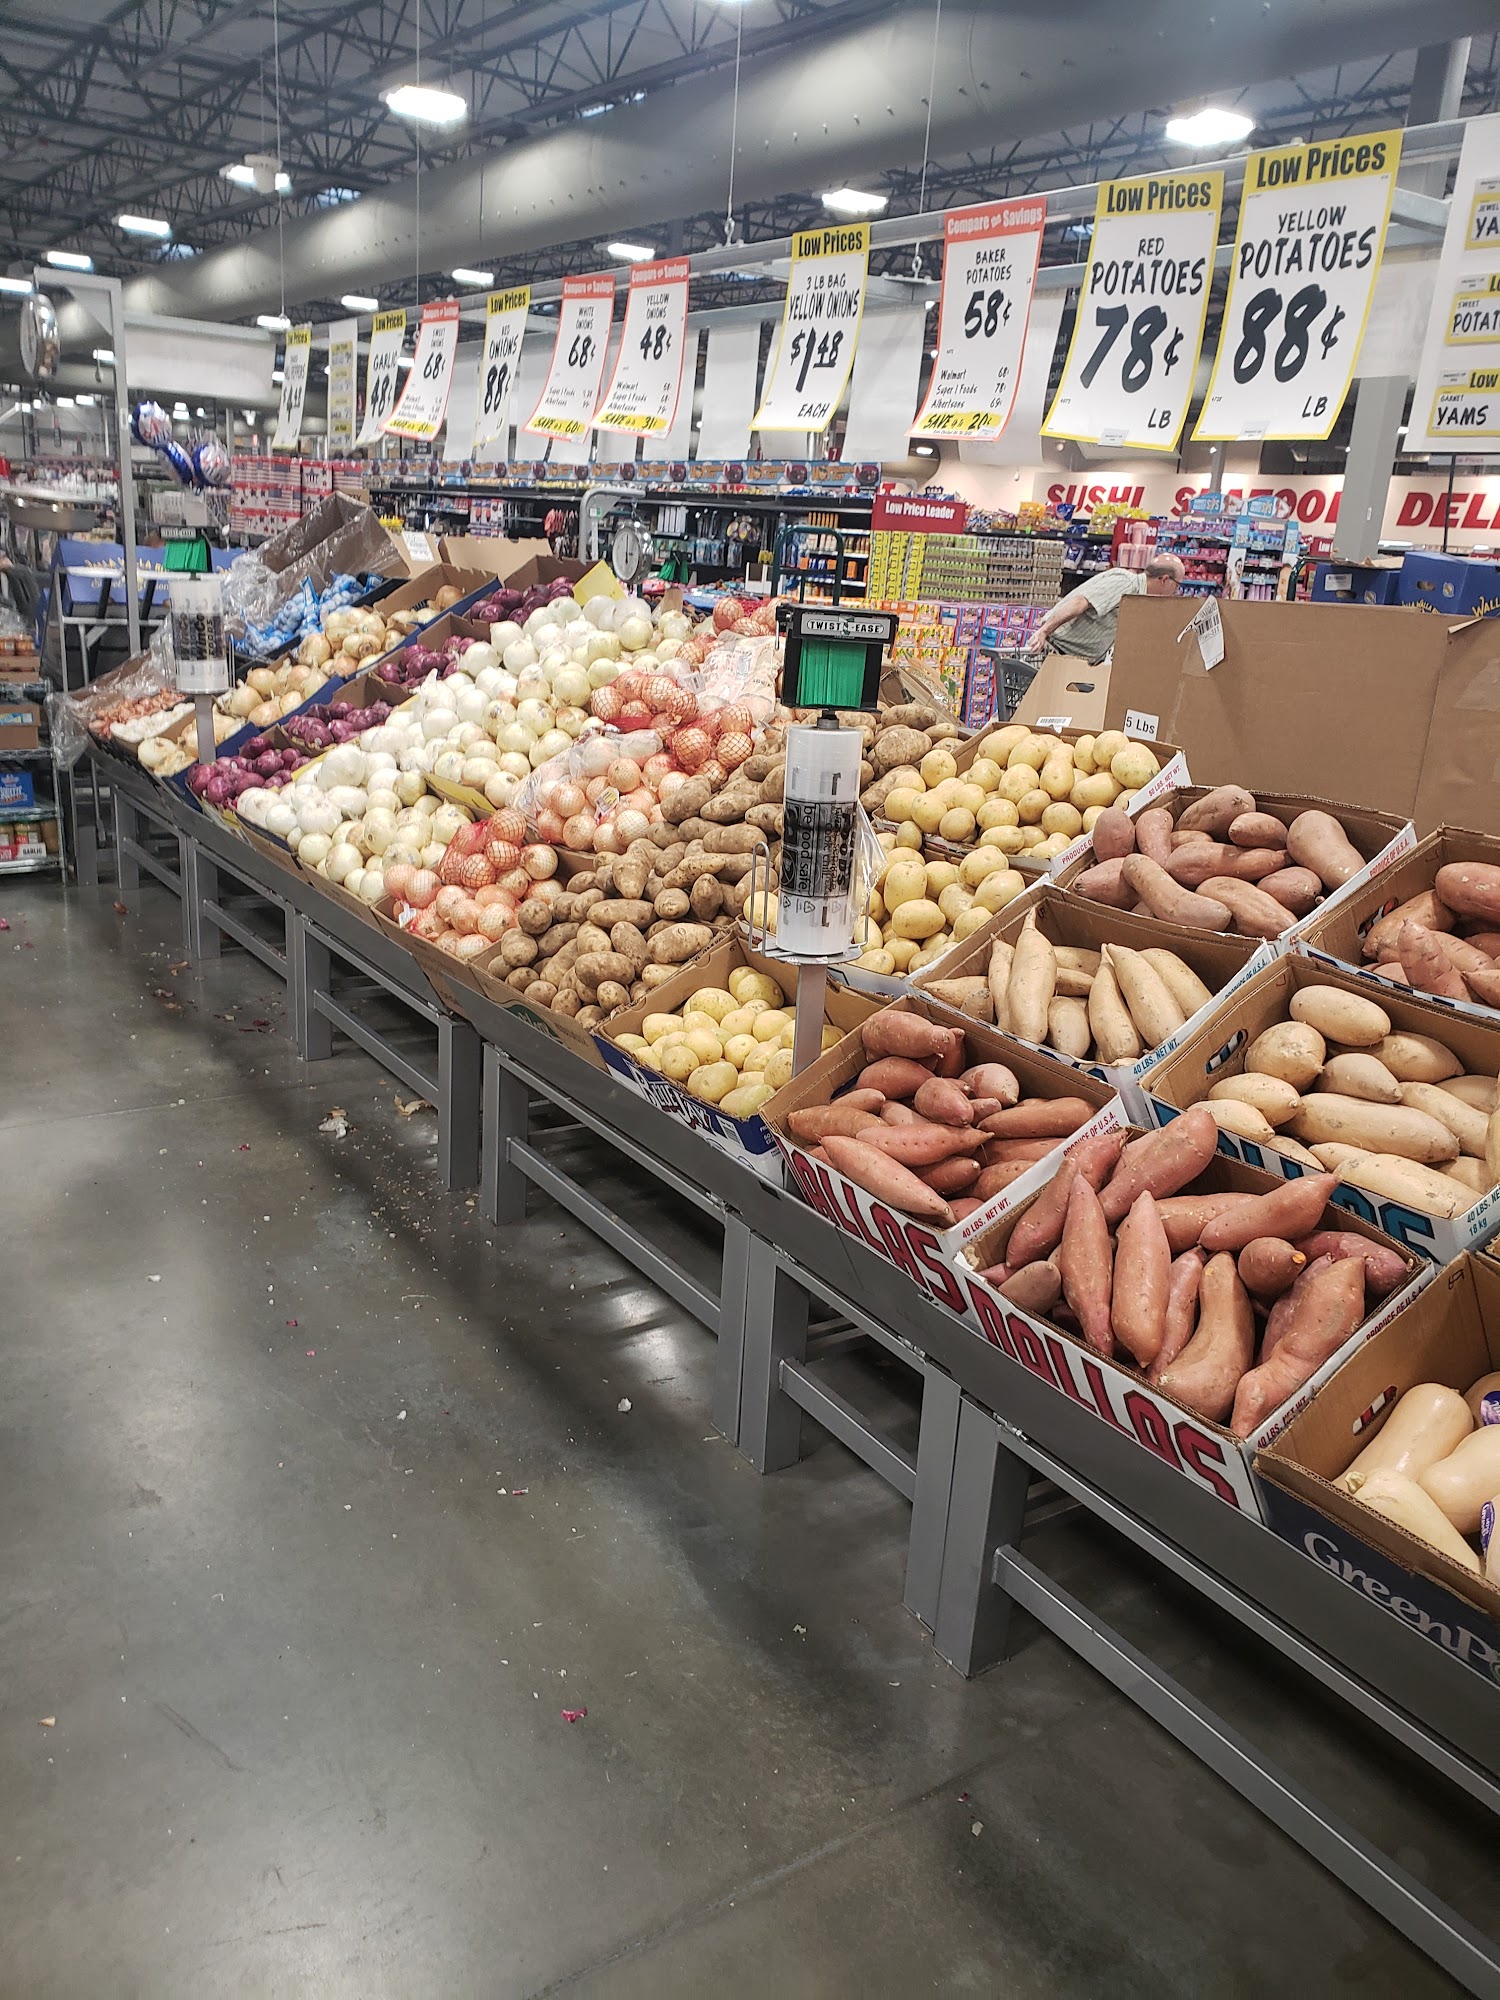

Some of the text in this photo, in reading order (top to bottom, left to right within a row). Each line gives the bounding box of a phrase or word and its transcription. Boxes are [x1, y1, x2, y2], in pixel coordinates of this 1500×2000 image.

[1257, 142, 1387, 188] Low Prices
[1107, 180, 1211, 213] Low Prices
[1478, 203, 1499, 212] JEWEL
[948, 215, 990, 235] Compare
[1003, 207, 1043, 227] Savings
[1278, 205, 1347, 234] YELLOW
[1476, 216, 1500, 239] YA
[799, 230, 862, 257] Low Prices
[1138, 237, 1165, 257] RED
[1239, 226, 1376, 280] POTATOES
[975, 248, 1006, 265] BAKER
[806, 273, 846, 291] 3 LB BAG
[966, 264, 1012, 285] POTATOES
[1090, 257, 1206, 296] POTATOES
[490, 291, 526, 314] Low Prices
[646, 293, 670, 306] YELLOW
[789, 288, 860, 321] YELLOW ONIONS
[1458, 300, 1480, 309] SWEET
[375, 314, 403, 331] Low Prices
[646, 306, 667, 320] ONIONS
[488, 334, 519, 361] ONIONS
[373, 351, 398, 371] GARLIC
[940, 369, 967, 380] Walmart
[936, 384, 955, 395] Super
[960, 383, 977, 394] Foods
[1440, 394, 1465, 403] GARNET
[797, 403, 830, 418] EACH
[931, 398, 965, 409] Albertsons
[1301, 396, 1328, 419] LB
[923, 413, 954, 430] SAVE
[1147, 408, 1172, 429] LB
[1437, 405, 1489, 426] YAMS
[885, 499, 955, 520] Low Price Leader
[1047, 484, 1145, 514] SUSHI
[810, 620, 840, 631] TWIST
[1126, 716, 1155, 735] 5 Lbs
[802, 806, 815, 825] be
[1062, 843, 1087, 865] PRODUCE
[1389, 850, 1396, 862] OF
[799, 861, 813, 893] safe
[1133, 1037, 1181, 1075] 40 LBS. NET WT.
[1089, 1125, 1098, 1138] OF
[1097, 1111, 1117, 1131] U.S.A.
[962, 1197, 1012, 1239] 40 LBS. NET WT.
[1467, 1210, 1476, 1224] 40
[1476, 1199, 1491, 1217] LBS.
[1469, 1217, 1488, 1237] 18 kg
[1257, 1436, 1267, 1449] 40
[1266, 1422, 1283, 1441] LBS.
